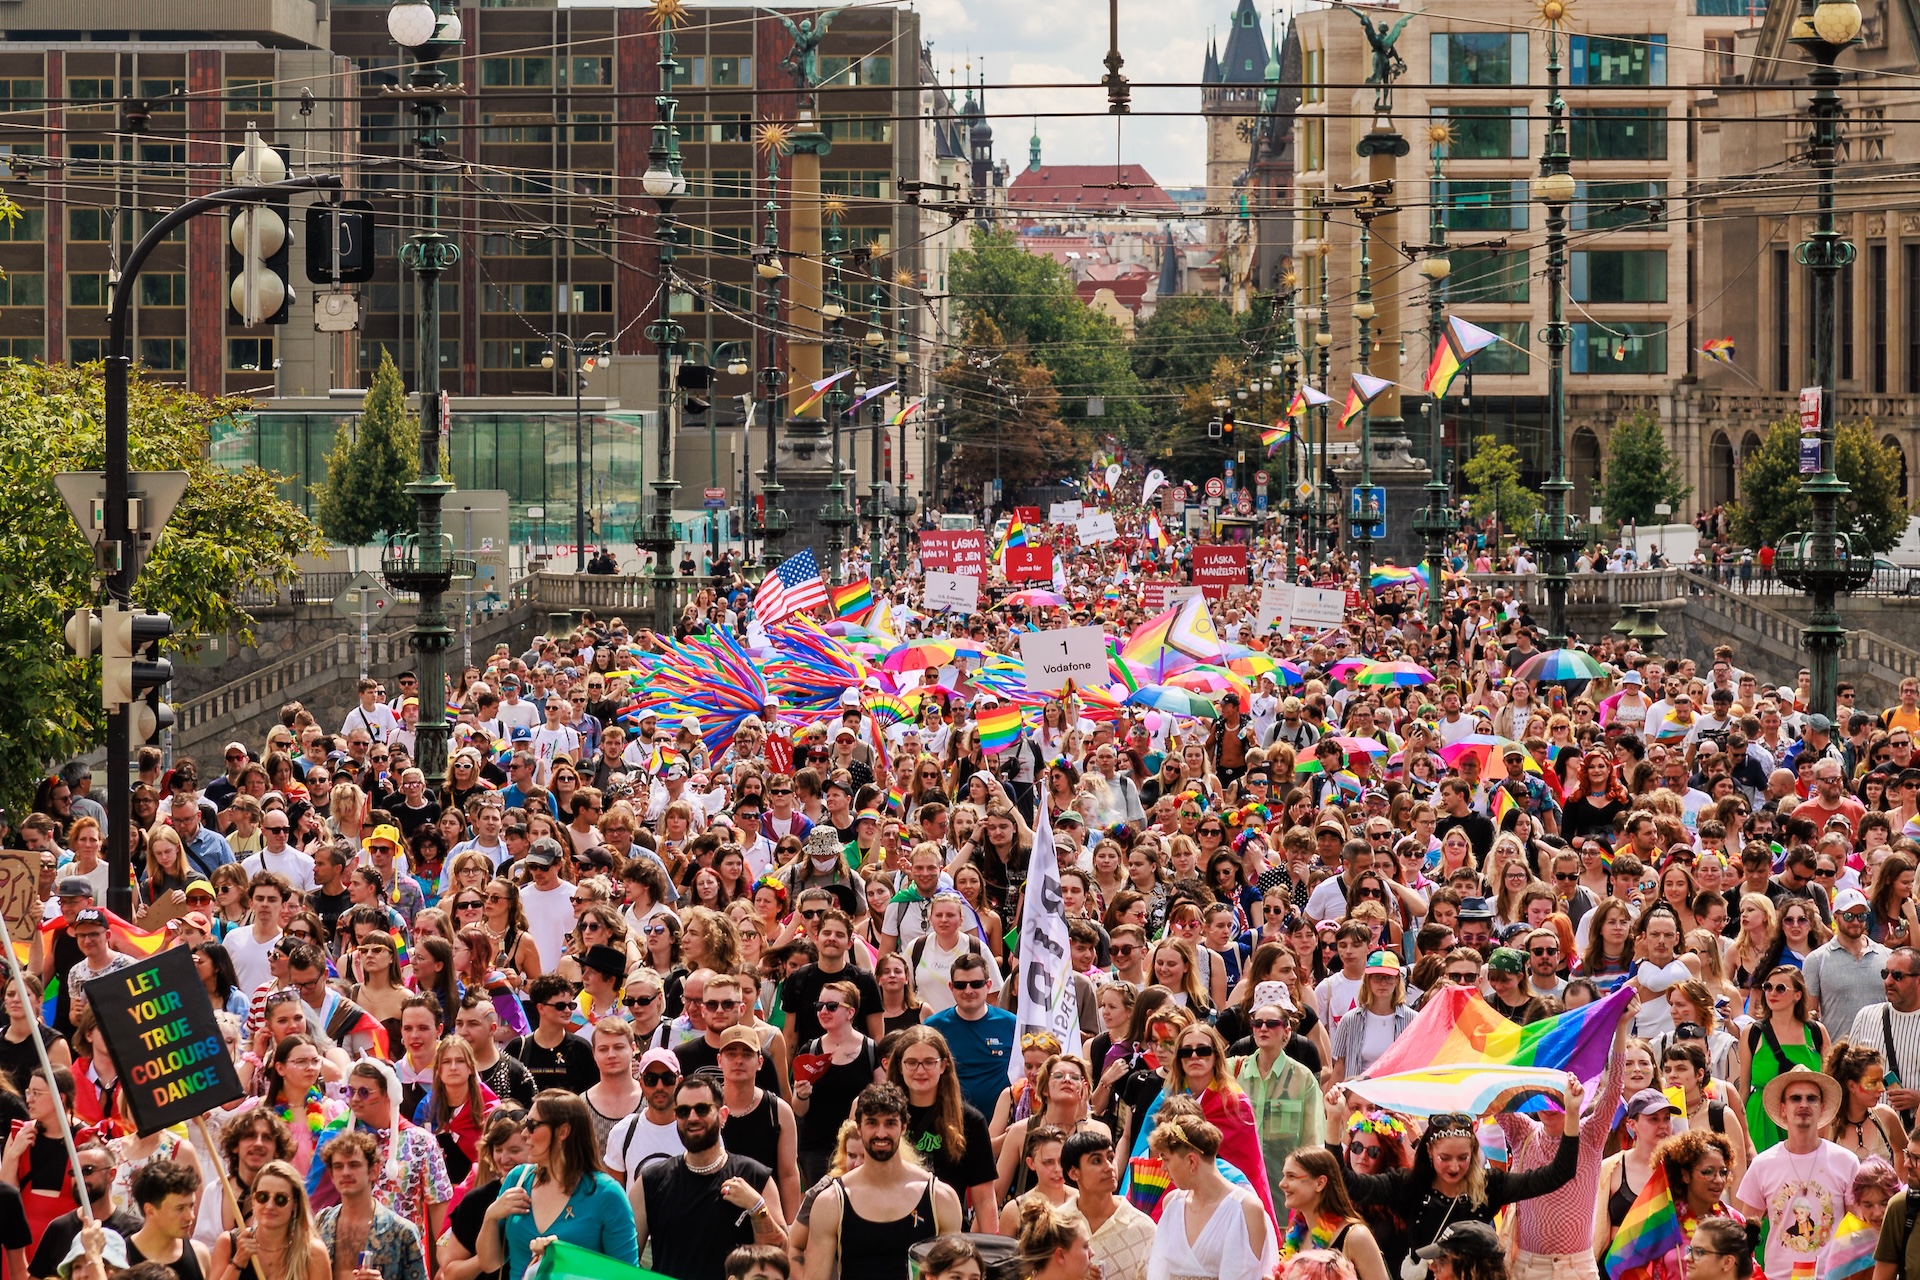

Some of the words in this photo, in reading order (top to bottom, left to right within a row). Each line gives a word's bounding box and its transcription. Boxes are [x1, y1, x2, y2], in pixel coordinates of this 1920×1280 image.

[951, 538, 980, 550] LÁSKA
[953, 552, 963, 562] JE
[965, 551, 981, 561] JEN
[1026, 552, 1033, 562] 3
[1203, 556, 1208, 564] 1
[1210, 554, 1236, 564] LÁSKA,
[954, 564, 982, 575] JEDNA
[1195, 568, 1200, 576] 1
[1201, 566, 1246, 576] MANŽELSTVÍ
[949, 581, 956, 591] 2
[1060, 640, 1068, 655] 1
[1043, 662, 1092, 674] Vodafone
[126, 967, 162, 997] LET
[127, 991, 183, 1025] YOUR
[139, 1017, 193, 1051] TRUE
[131, 1035, 220, 1085] COLOURS
[152, 1066, 220, 1108] DANCE
